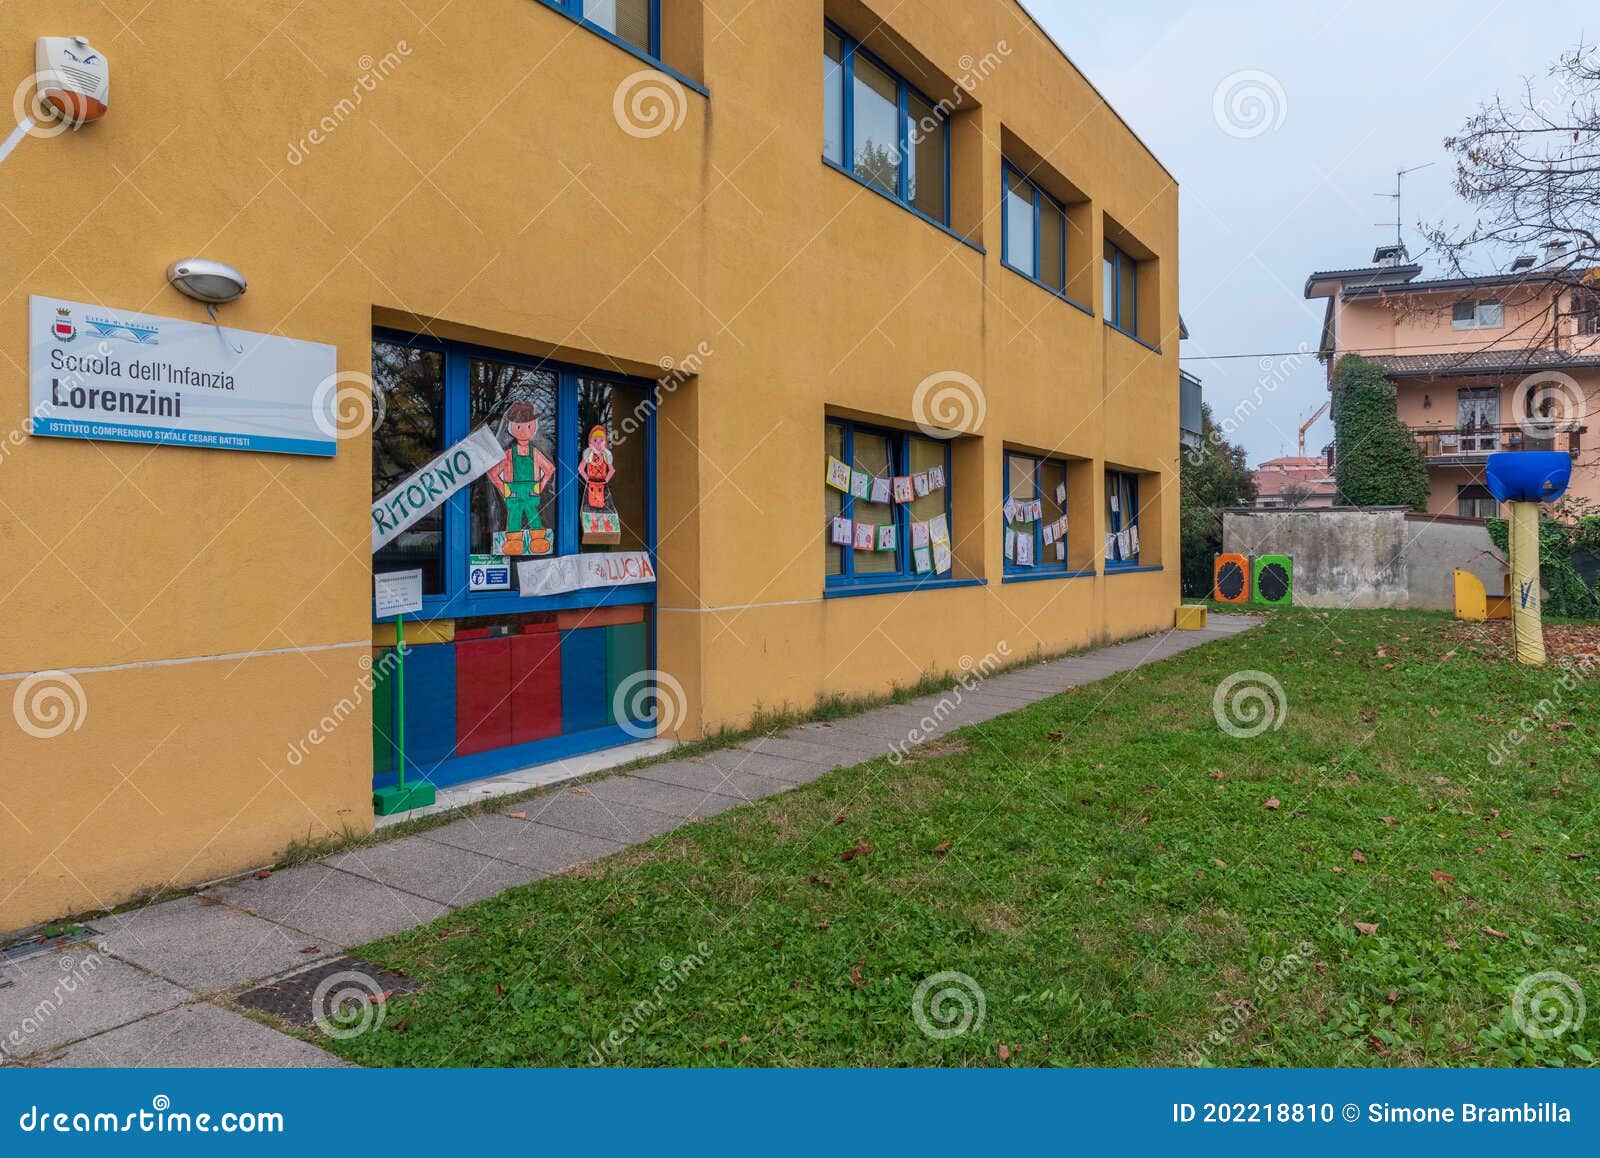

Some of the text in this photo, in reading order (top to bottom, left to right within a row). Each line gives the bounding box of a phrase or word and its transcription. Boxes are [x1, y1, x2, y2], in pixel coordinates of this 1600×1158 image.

[51, 349, 235, 390] Scuola dell'Infanzia
[52, 378, 181, 418] Lorenzini
[50, 421, 251, 447] ISTITUTO COMPRENSIVO STATALE CESARE BATTISTI
[371, 449, 472, 535] RITORNO
[605, 555, 654, 581] LUCIA
